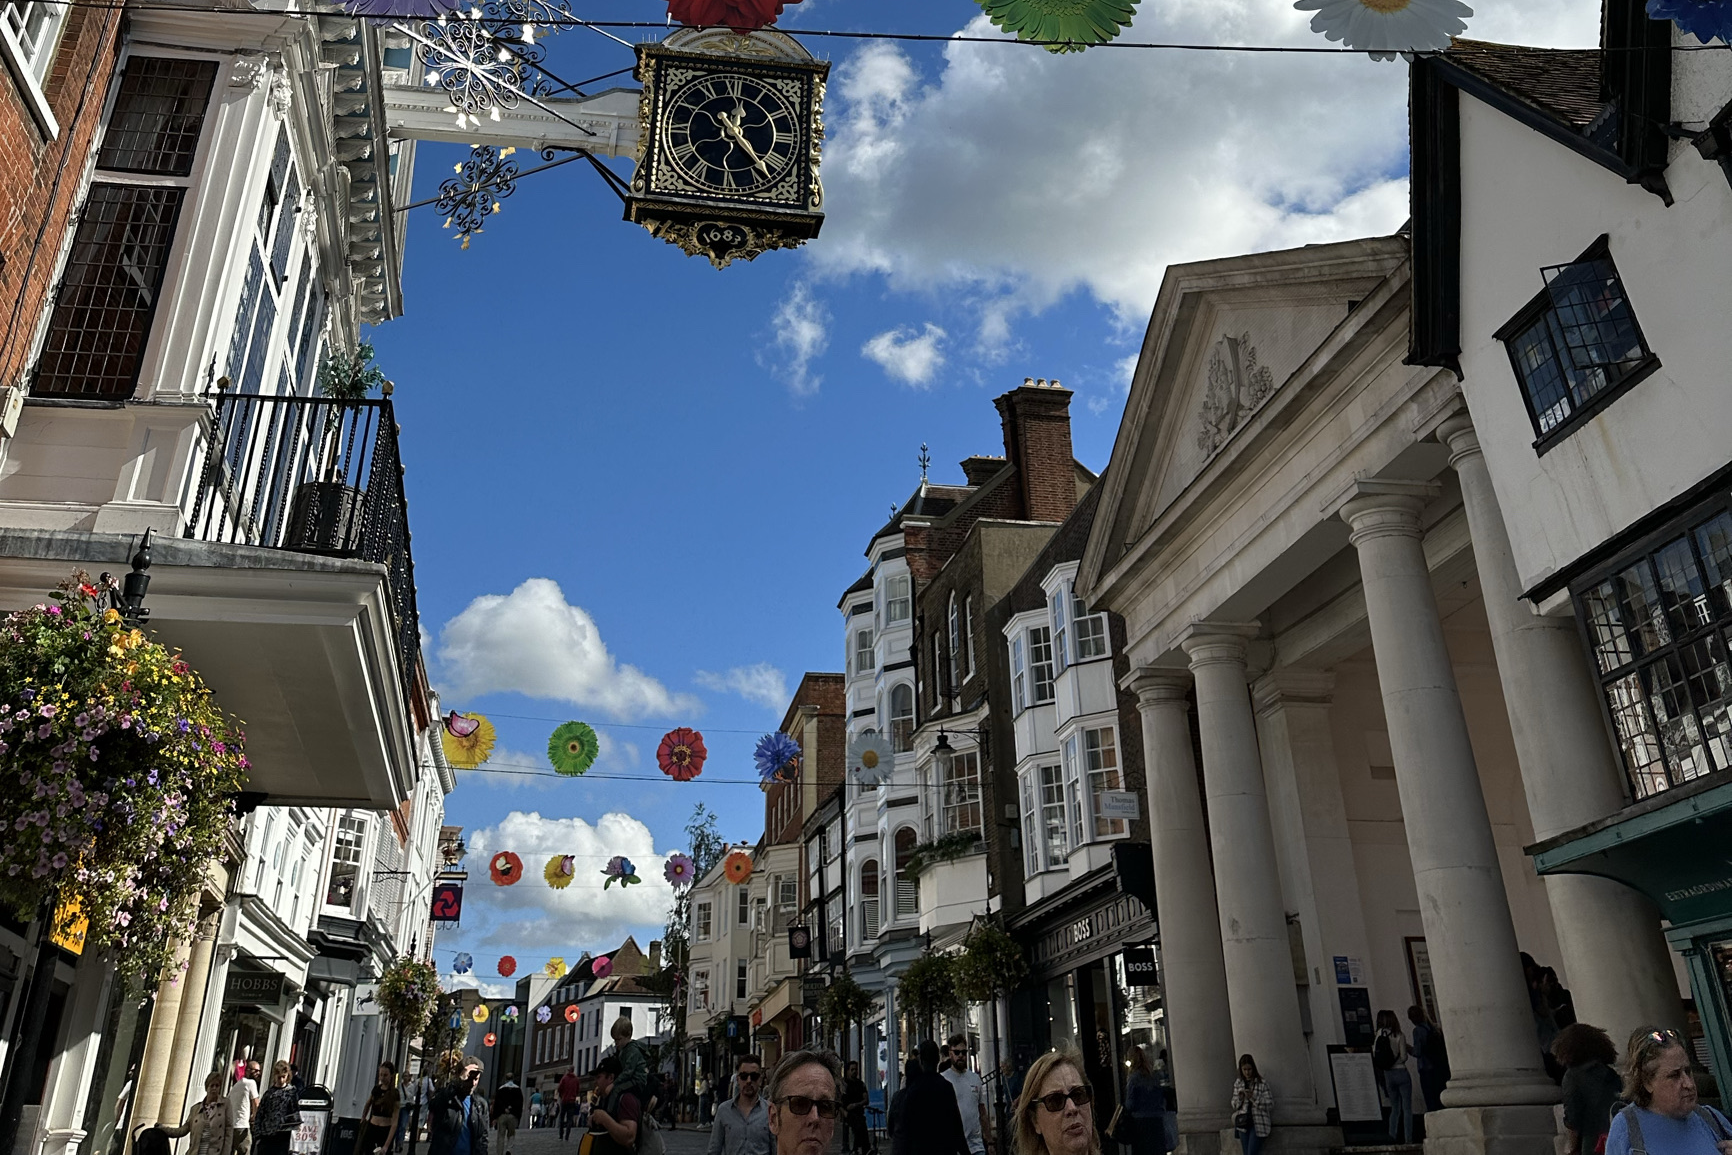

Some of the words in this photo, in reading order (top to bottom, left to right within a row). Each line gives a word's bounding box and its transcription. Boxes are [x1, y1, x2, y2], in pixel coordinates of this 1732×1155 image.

[700, 82, 717, 101] XI
[725, 80, 743, 96] XII
[755, 90, 766, 103] I
[680, 98, 697, 113] X
[769, 109, 788, 119] II
[670, 122, 690, 134] IX
[775, 132, 793, 144] III
[674, 144, 694, 164] VIII
[764, 151, 787, 171] IIII
[690, 160, 708, 182] VII
[751, 167, 764, 185] V
[723, 170, 737, 188] VI
[702, 228, 741, 245] 1683
[1104, 803, 1136, 811] Mansfield
[1110, 796, 1135, 804] Thomas
[1073, 918, 1090, 943] BOSS
[1128, 962, 1154, 972] BOSS
[231, 977, 278, 990] HOBBS
[297, 1125, 318, 1133] SAVE
[295, 1133, 318, 1142] 30%
